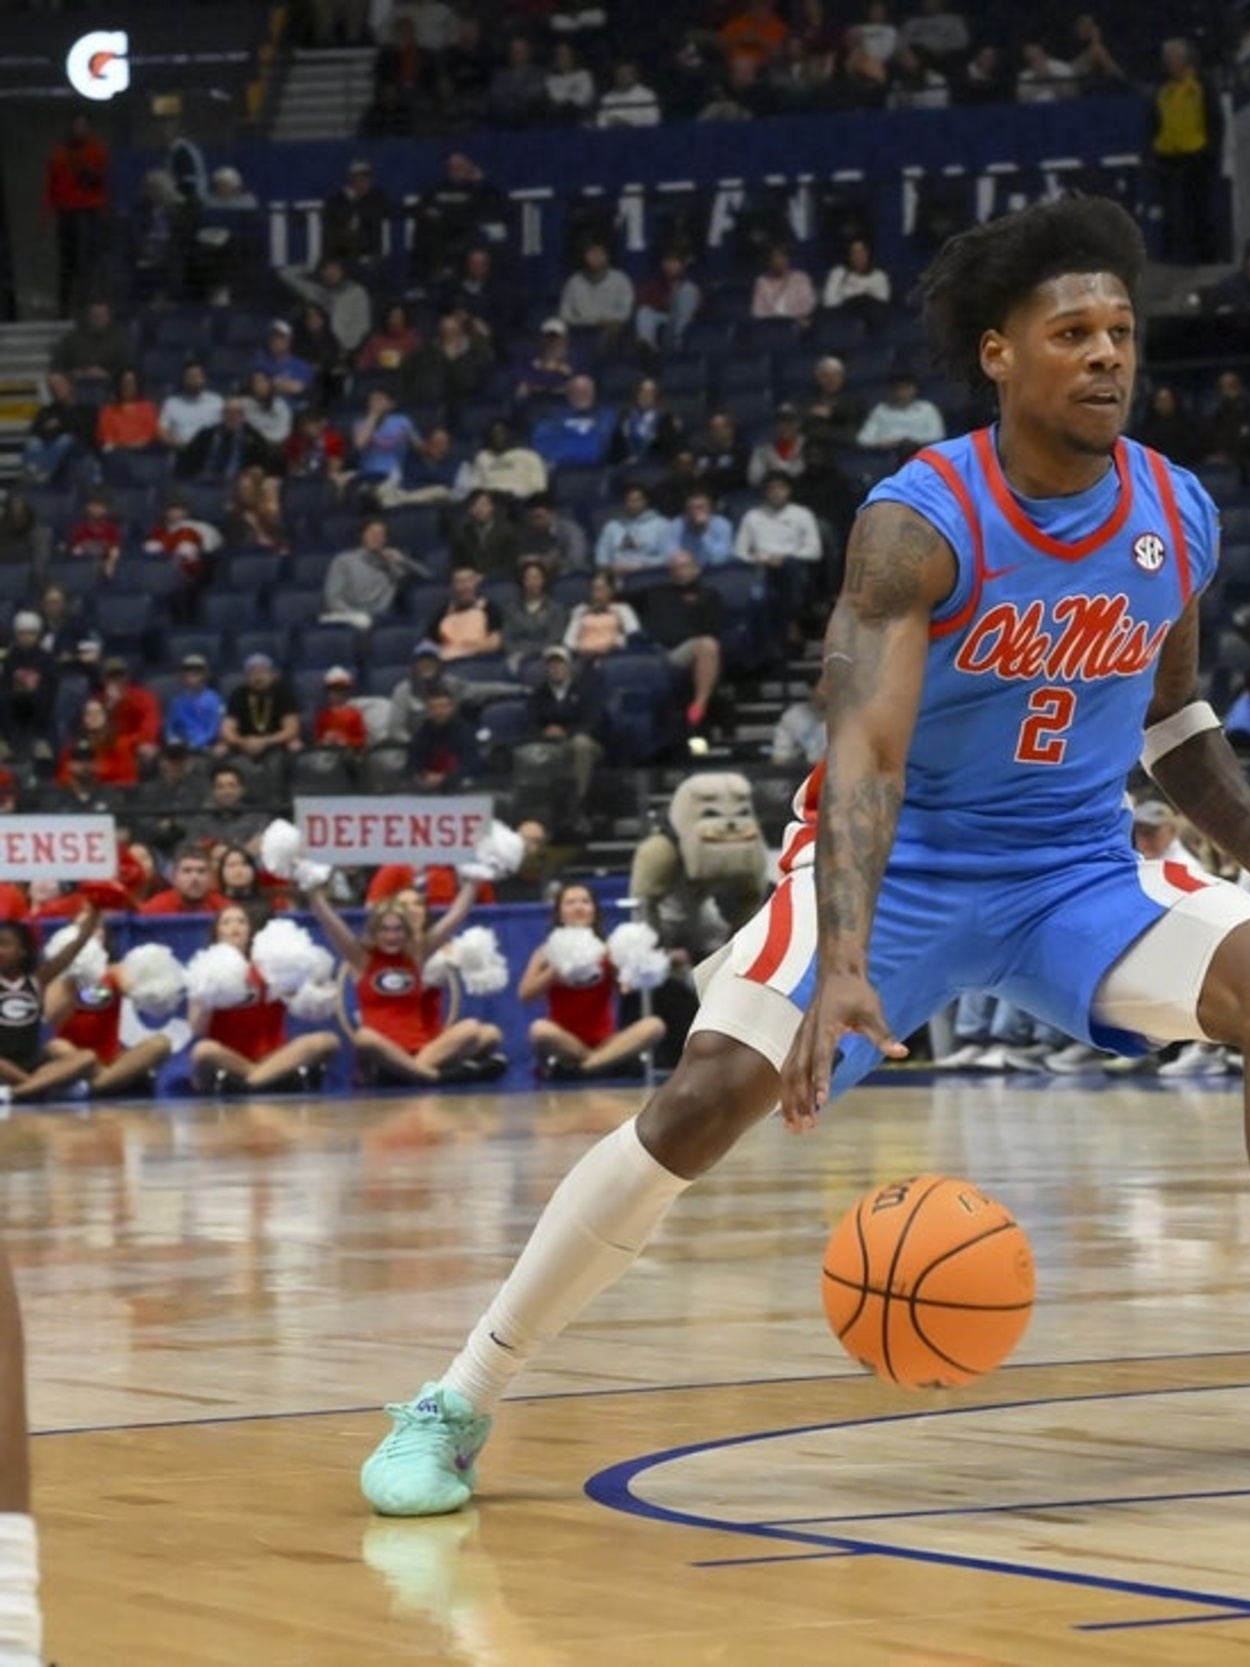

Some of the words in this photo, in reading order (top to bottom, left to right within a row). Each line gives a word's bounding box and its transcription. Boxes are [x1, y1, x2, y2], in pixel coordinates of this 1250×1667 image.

[66, 31, 130, 100] G
[1134, 534, 1164, 570] SEC
[955, 600, 1051, 681] Ole
[1014, 686, 1077, 765] 2
[306, 813, 483, 848] DEFENSE
